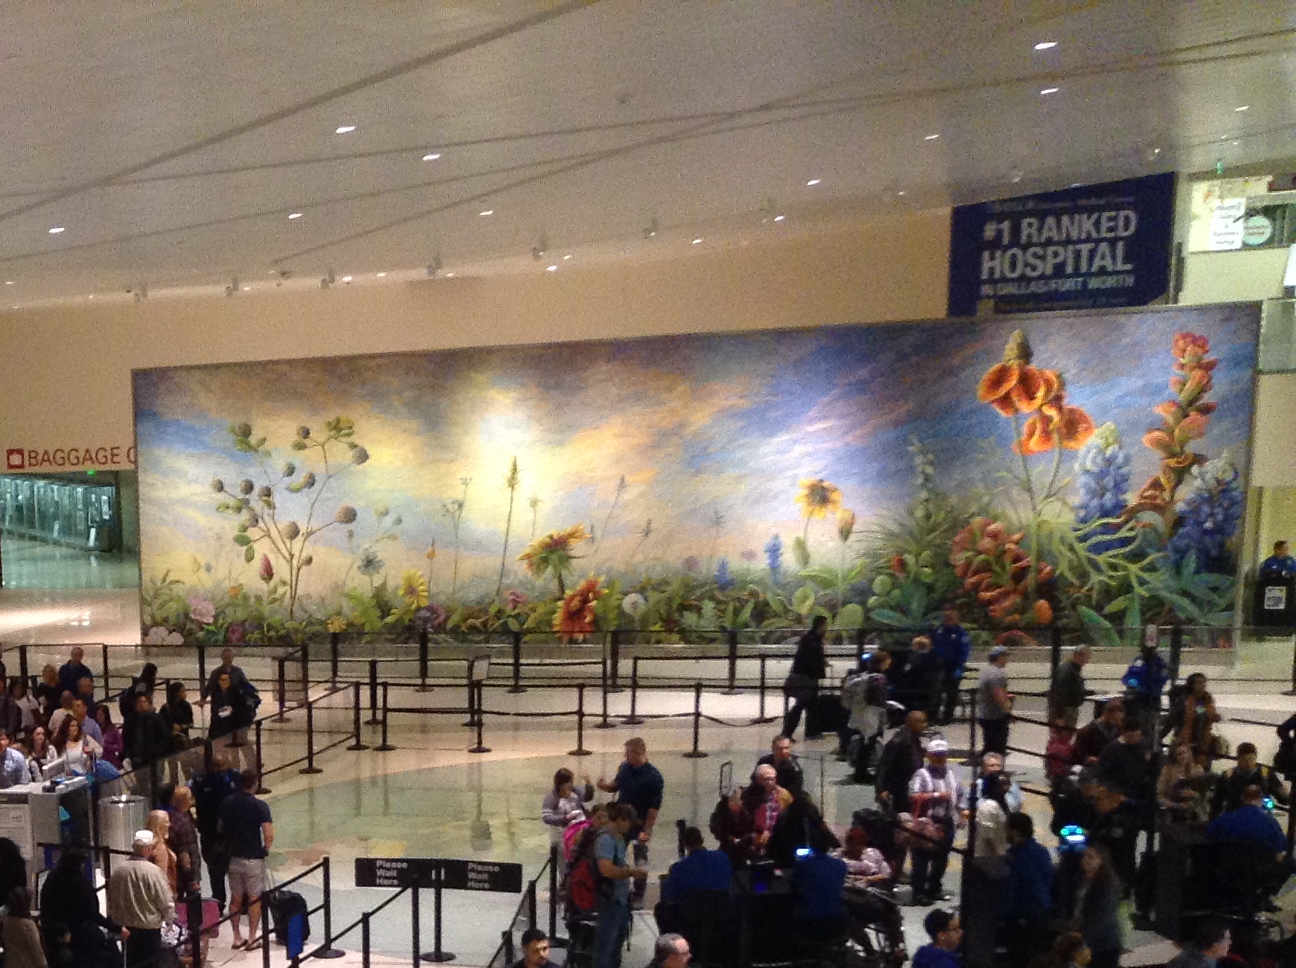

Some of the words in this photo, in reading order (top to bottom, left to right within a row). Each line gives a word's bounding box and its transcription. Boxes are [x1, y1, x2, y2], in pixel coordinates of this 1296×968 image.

[982, 219, 1011, 246] #1
[1019, 209, 1138, 245] RANKED
[980, 240, 1134, 280] HOSPITAL
[27, 446, 121, 468] BAGGAGE
[375, 859, 409, 869] Please
[467, 862, 501, 873] Please
[375, 869, 398, 878] Wait
[467, 871, 490, 881] Wait
[375, 877, 399, 886] Here
[466, 880, 491, 889] Here
